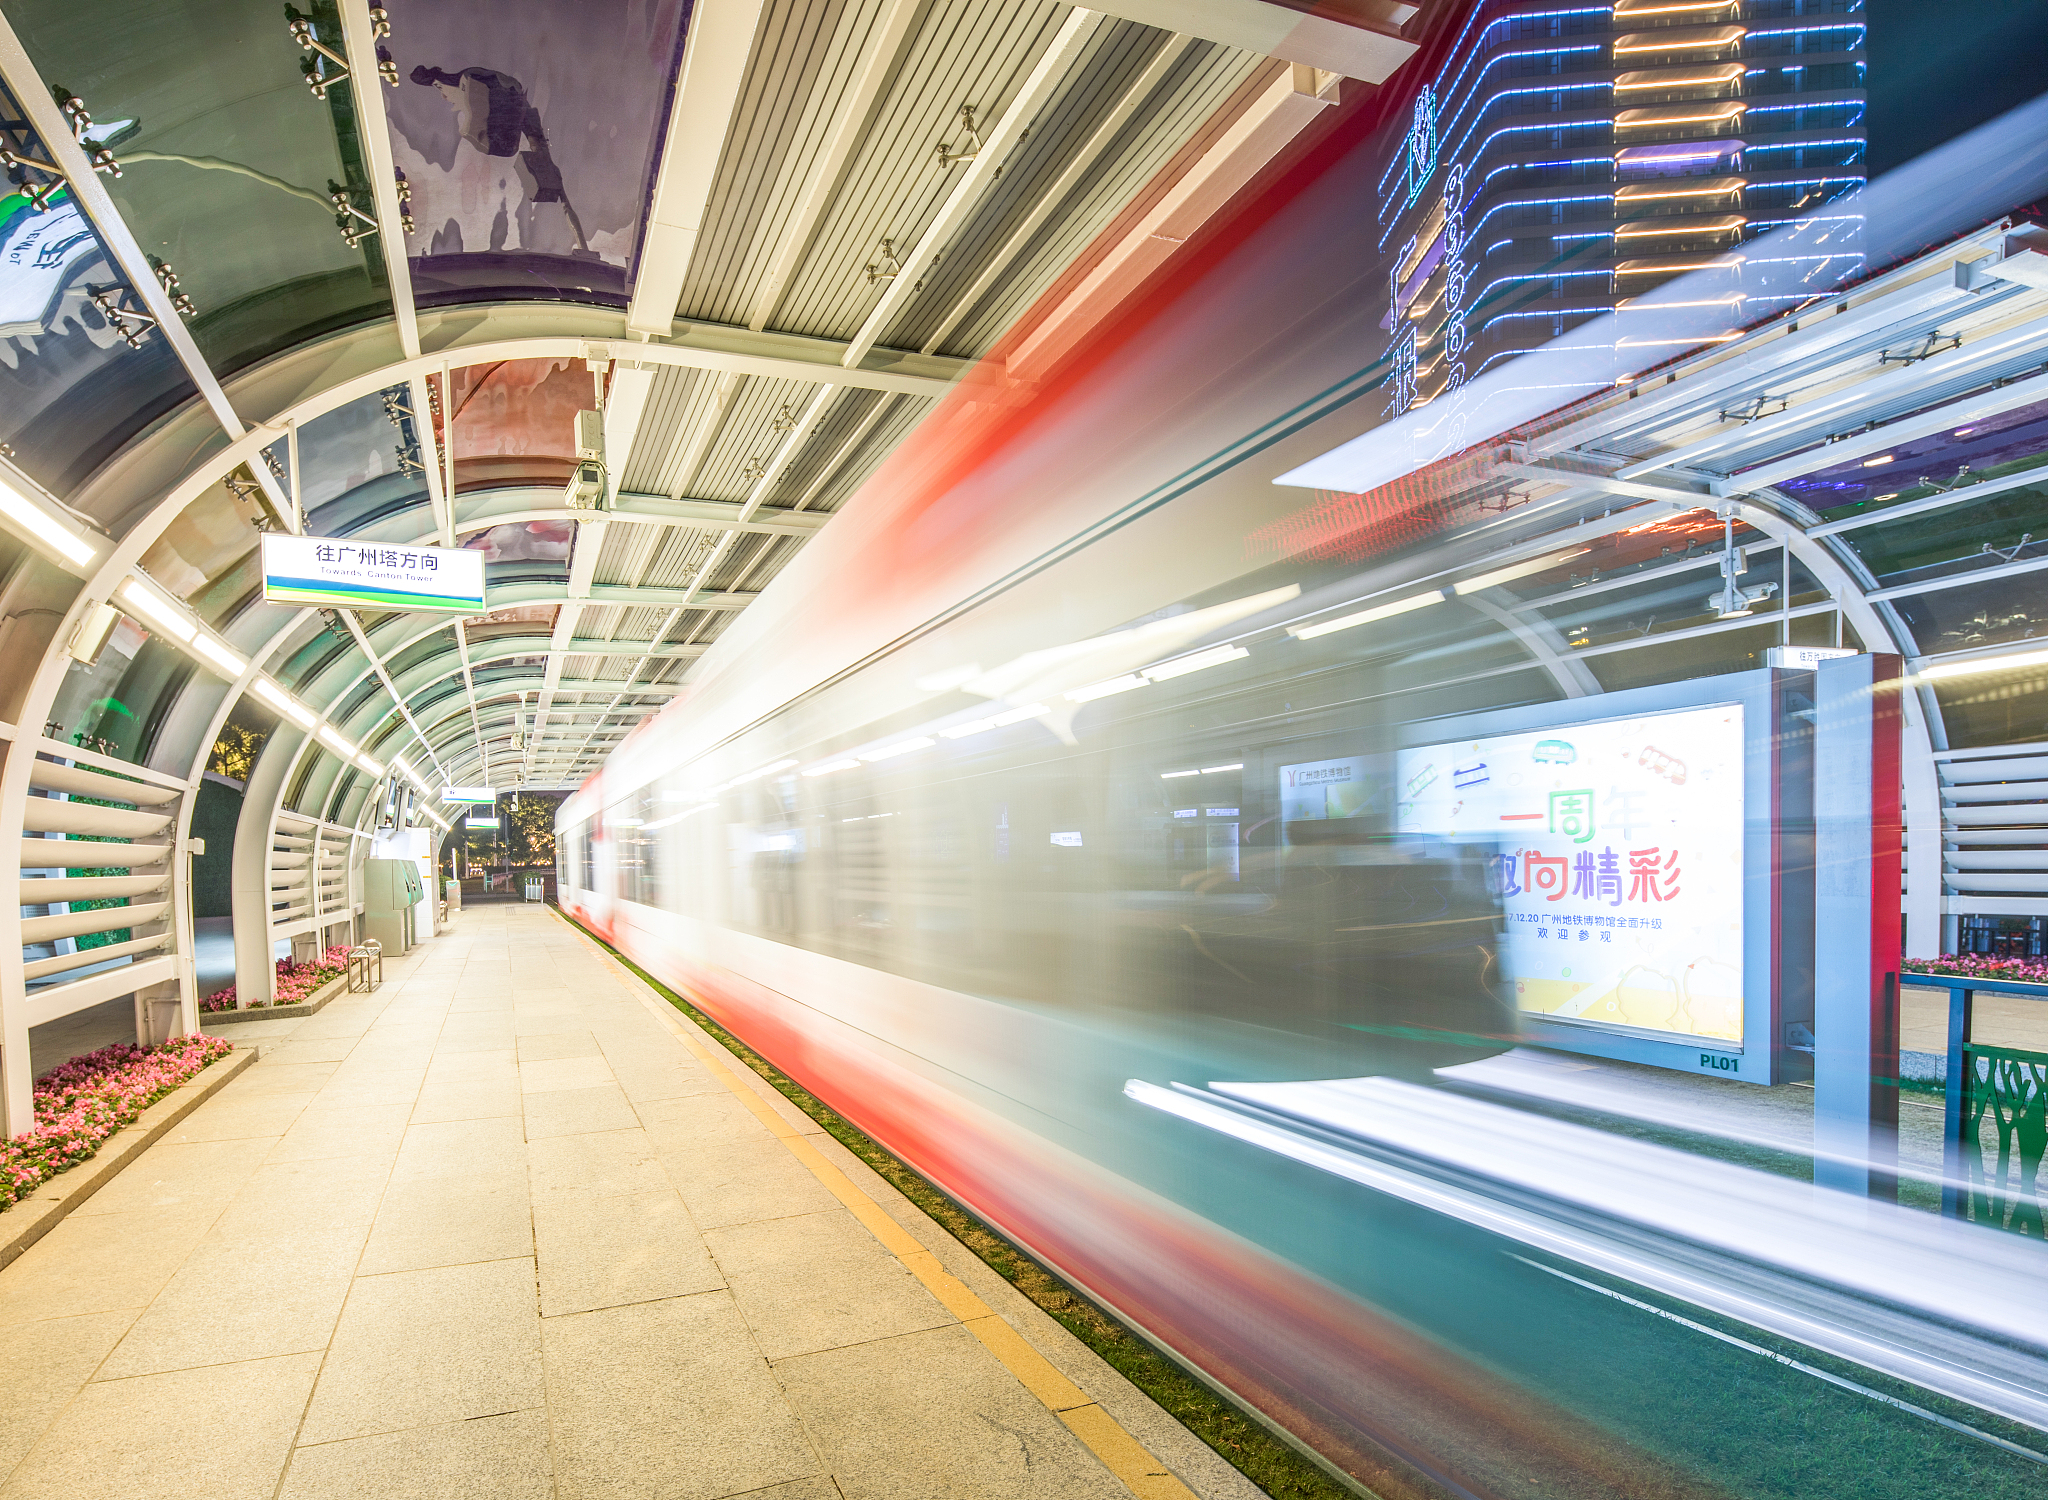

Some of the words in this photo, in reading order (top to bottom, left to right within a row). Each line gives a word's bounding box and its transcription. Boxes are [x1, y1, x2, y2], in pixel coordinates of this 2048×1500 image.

[316, 544, 438, 571] 往广州塔方向
[321, 566, 362, 577] Towards
[367, 570, 402, 580] Canton
[405, 573, 433, 582] Tower
[1298, 766, 1352, 781] 广州地铁博物馆
[1500, 786, 1653, 844] 一周年
[1541, 913, 1662, 930] 广州地铁博物馆全面升级
[1537, 927, 1612, 943] 欢迎参观
[1700, 1053, 1739, 1073] PL01
